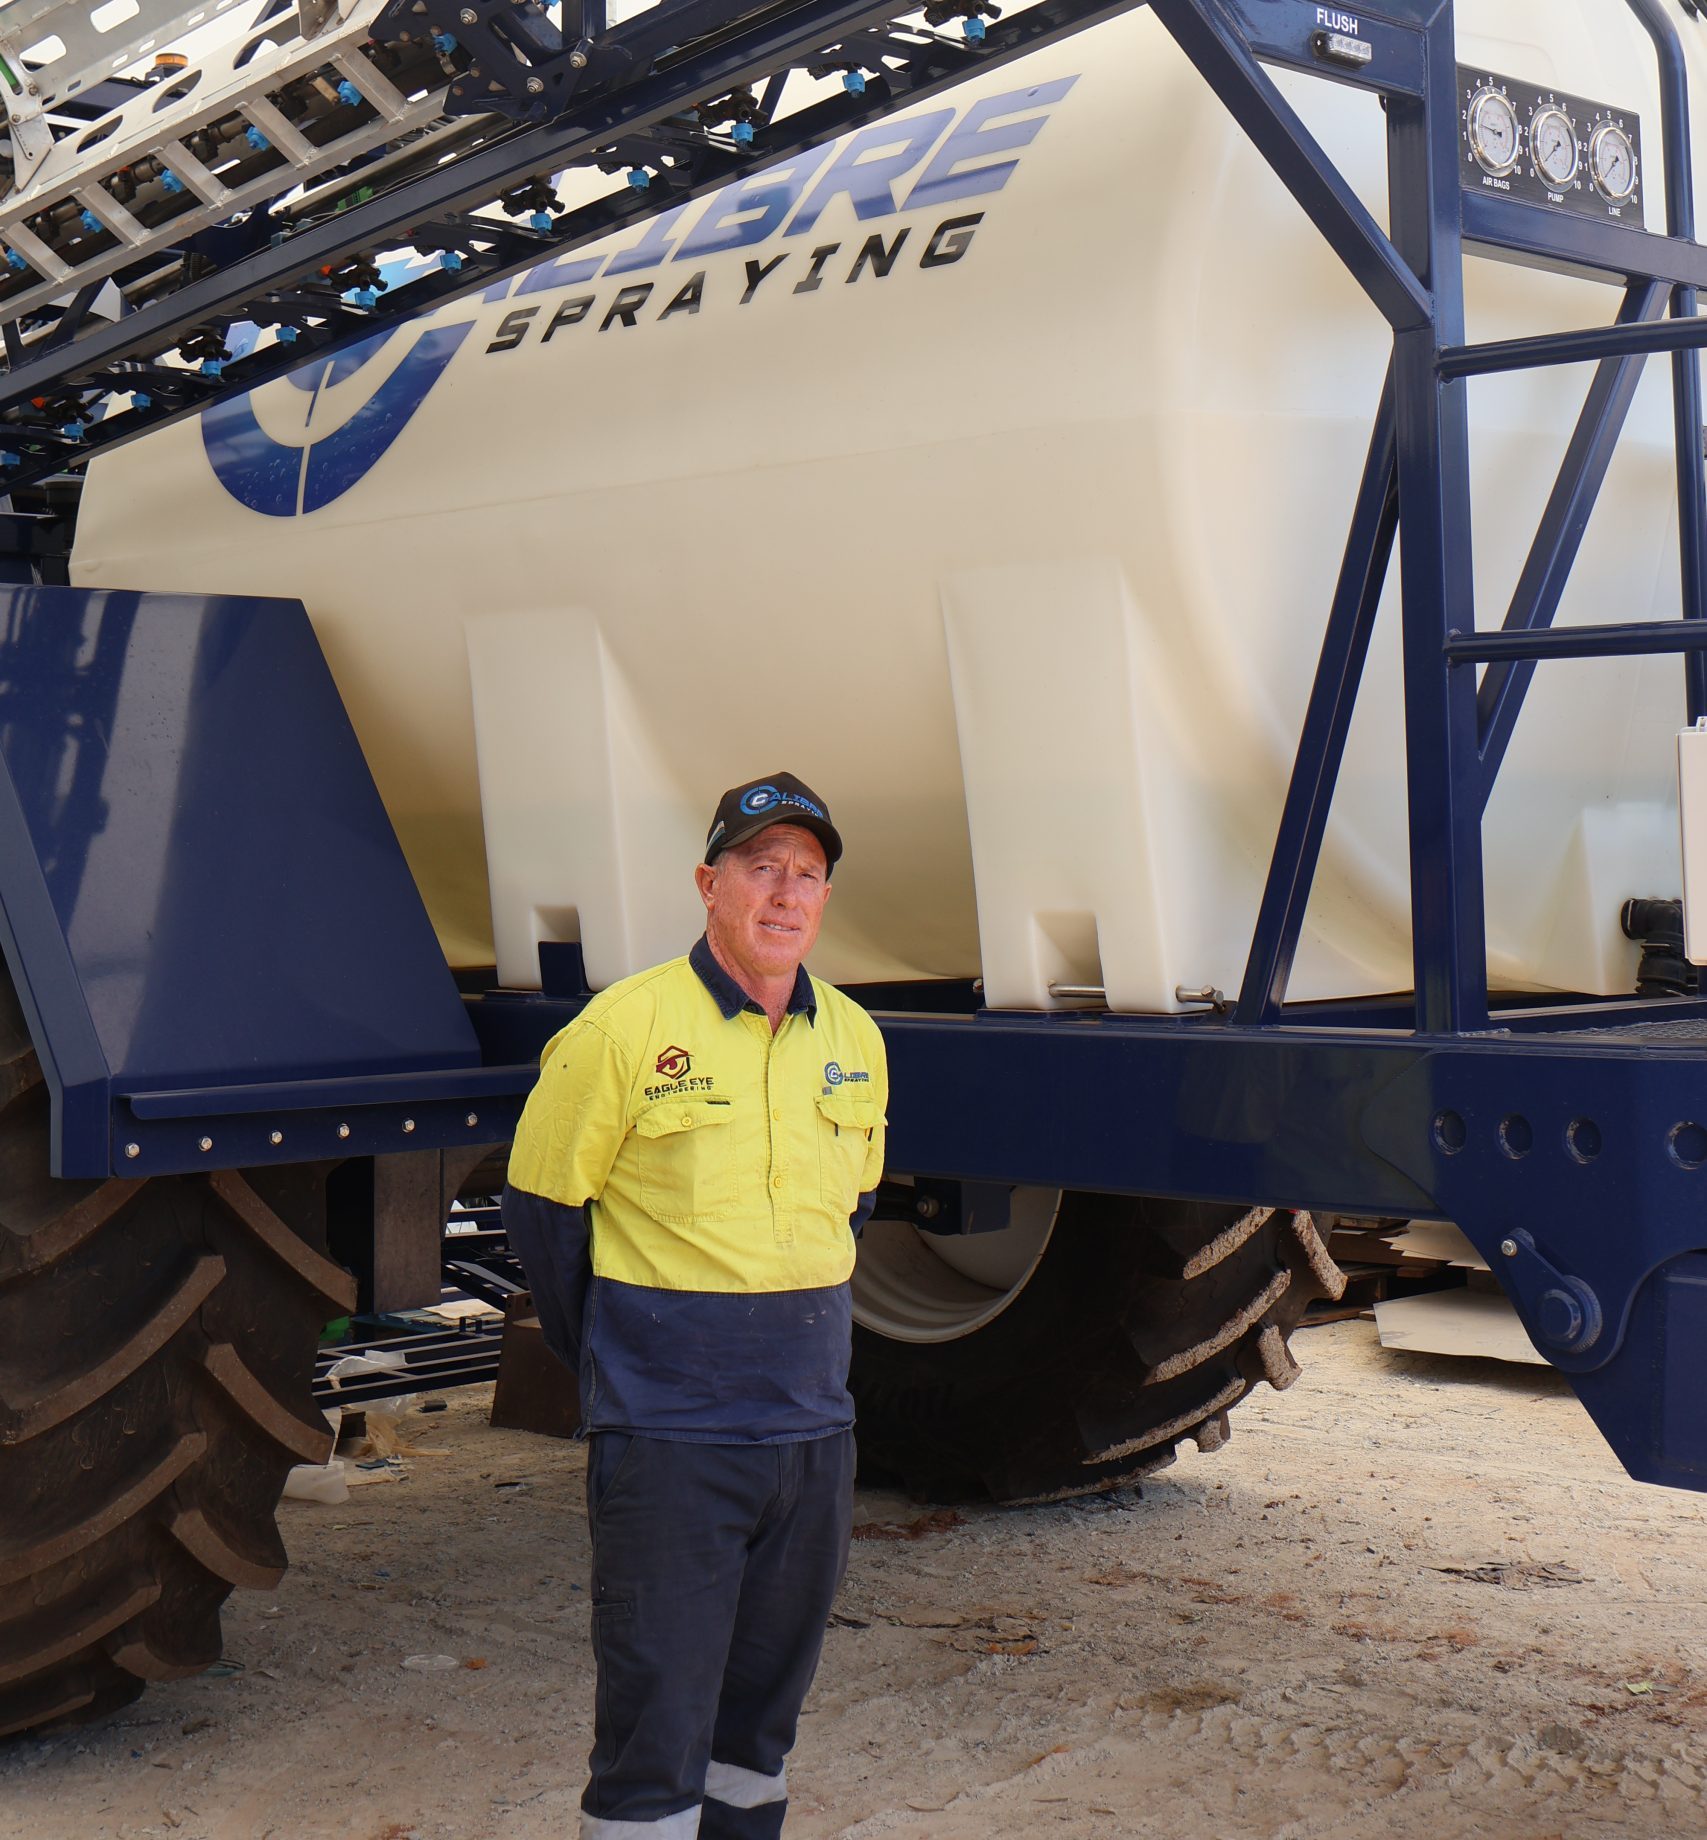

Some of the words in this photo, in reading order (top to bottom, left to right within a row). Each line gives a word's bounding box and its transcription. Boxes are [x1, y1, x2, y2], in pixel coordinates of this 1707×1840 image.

[1316, 7, 1358, 35] FLUSH
[1482, 176, 1493, 187] AIR
[1494, 178, 1510, 190] BAGS
[1548, 192, 1564, 203] PUMP
[1608, 206, 1622, 217] LINE
[485, 211, 985, 354] SPRAYING
[644, 1080, 687, 1096] EAGLE
[689, 1077, 714, 1086] EYE
